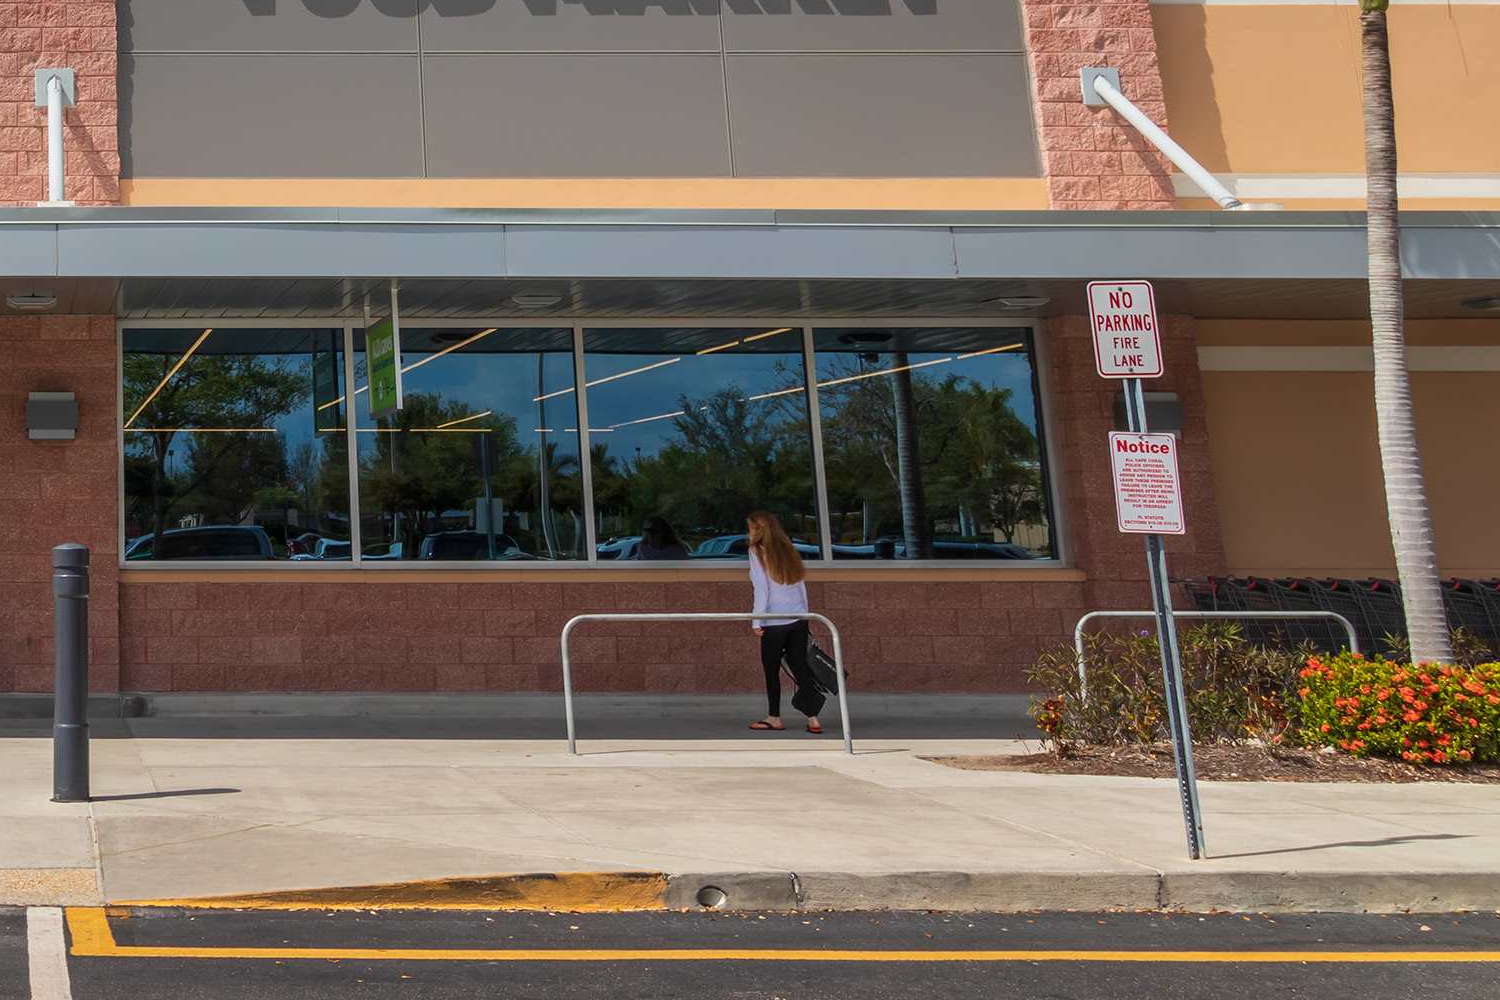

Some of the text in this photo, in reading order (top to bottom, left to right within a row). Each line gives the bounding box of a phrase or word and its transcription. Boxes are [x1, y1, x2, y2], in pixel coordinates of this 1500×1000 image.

[1109, 291, 1133, 309] NO
[1097, 313, 1152, 332] PARKING
[1113, 337, 1140, 349] FIRE
[1113, 354, 1144, 367] LANE
[1116, 439, 1170, 454] Notice
